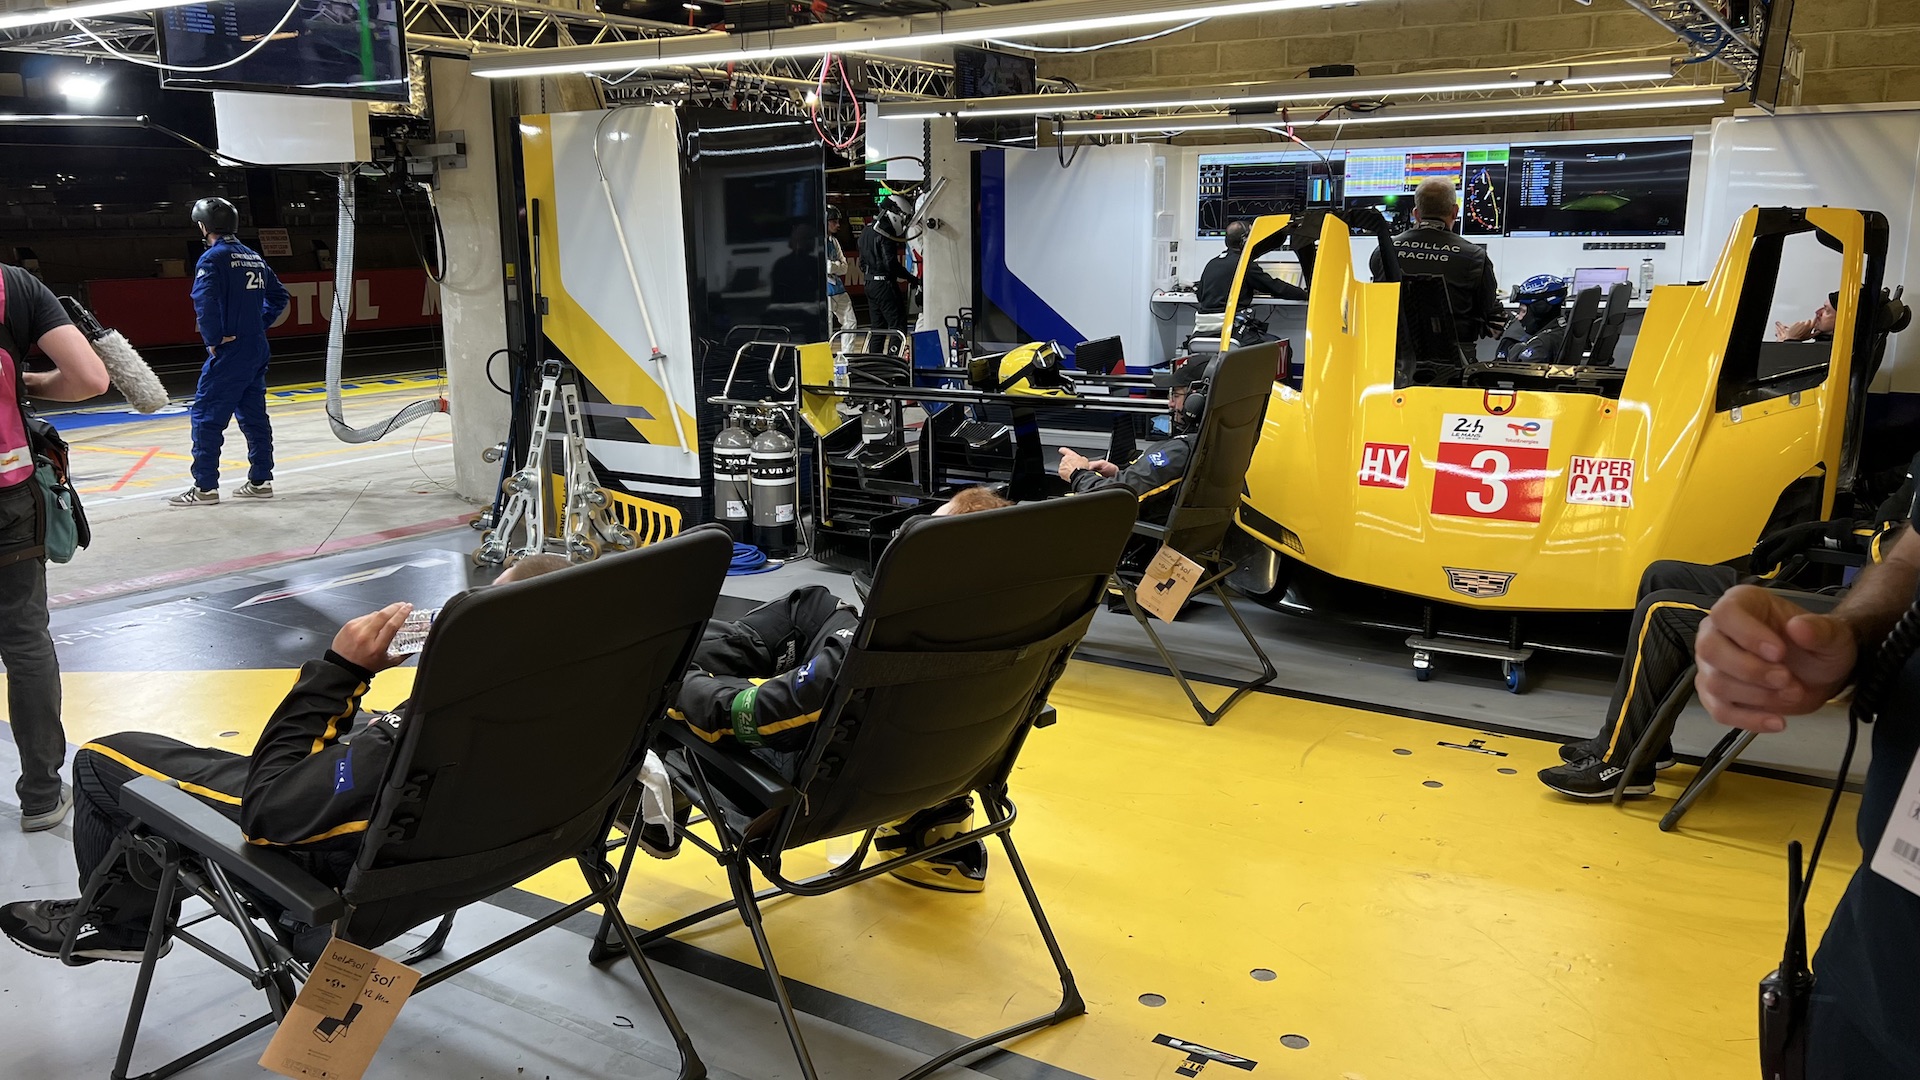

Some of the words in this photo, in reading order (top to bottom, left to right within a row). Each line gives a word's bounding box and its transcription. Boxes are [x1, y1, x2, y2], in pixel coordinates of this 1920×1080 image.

[1393, 241, 1460, 253] CADILLAC
[1397, 251, 1449, 262] RACING
[1453, 417, 1484, 433] 24h
[1361, 447, 1408, 484] HY
[1573, 458, 1632, 477] HYPER
[1465, 450, 1511, 513] 3
[1571, 474, 1630, 503] CAR
